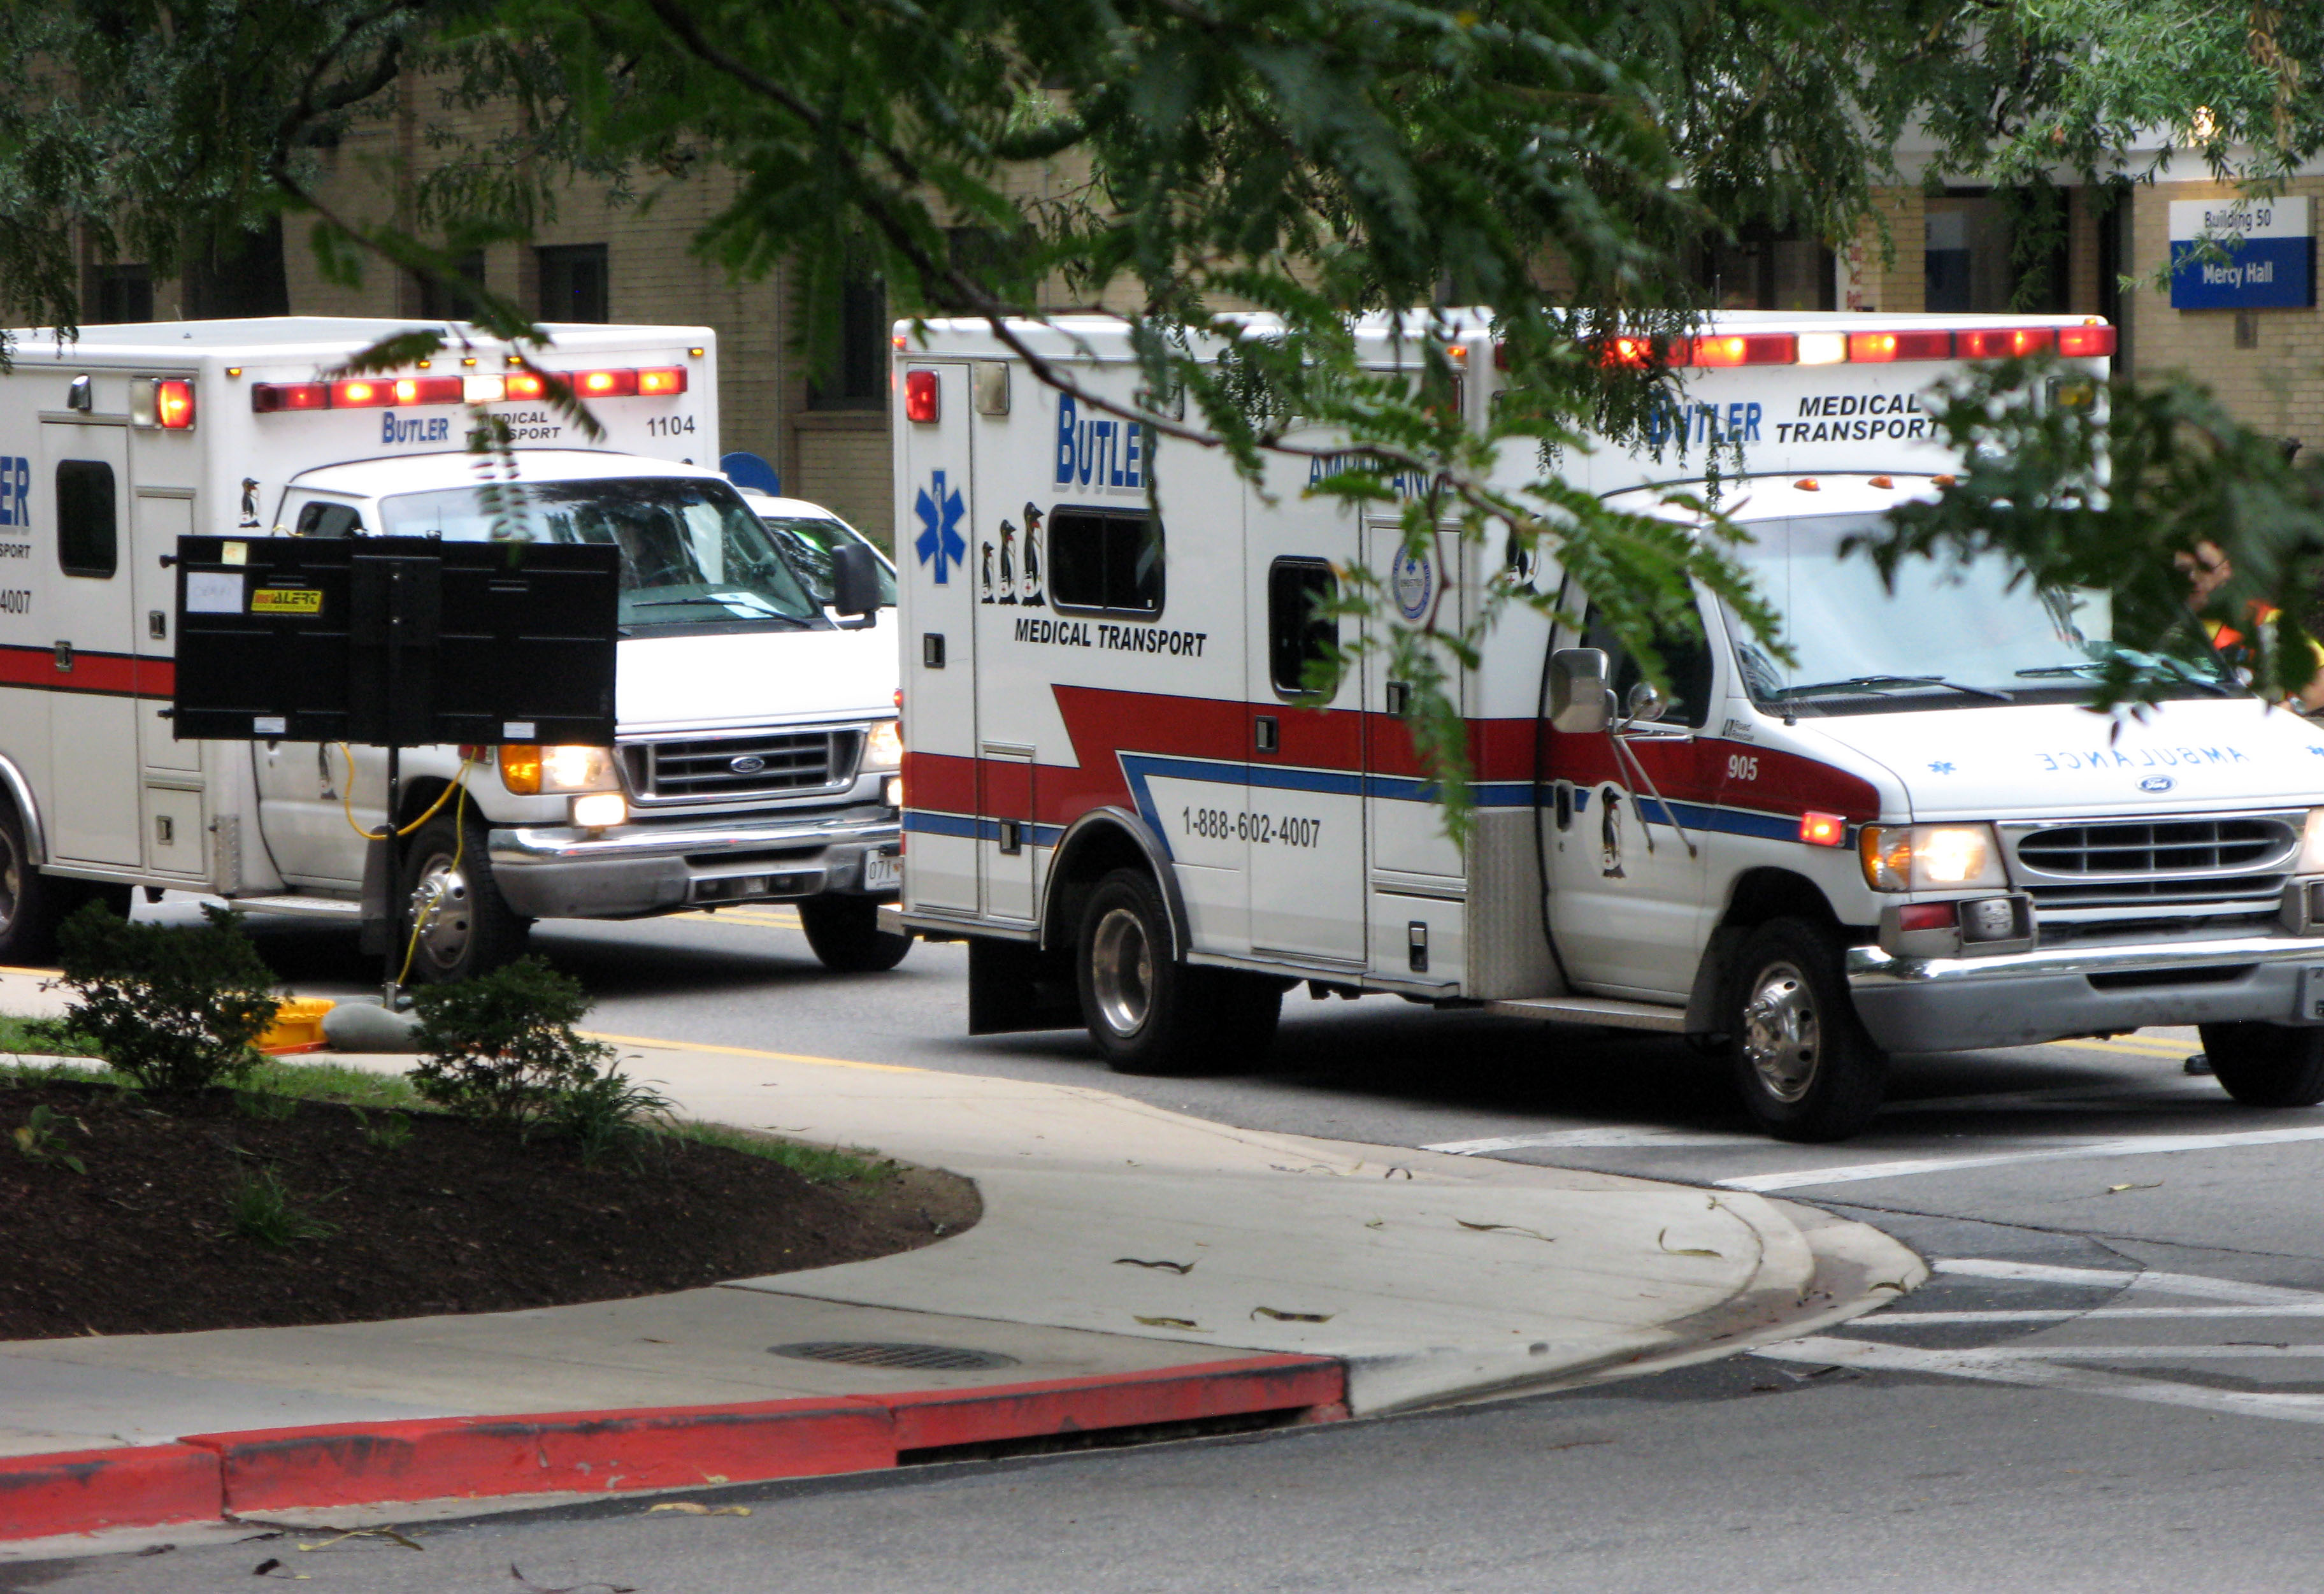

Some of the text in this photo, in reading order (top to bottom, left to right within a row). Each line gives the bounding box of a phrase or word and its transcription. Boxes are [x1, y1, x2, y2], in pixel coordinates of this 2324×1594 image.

[2204, 208, 2272, 231] Building 50
[2203, 261, 2273, 289] Mercy Hall
[478, 411, 549, 425] DICAL
[1798, 393, 1922, 417] MEDICAL
[382, 411, 448, 443] BUTLER
[466, 426, 561, 441] TSPORT
[646, 414, 696, 437] 1104
[1775, 417, 1940, 443] TRANSPORT
[1056, 391, 1157, 488] BUTLE
[1014, 618, 1207, 657] MEDICAL TRANSPORT
[1728, 754, 1759, 781] 905
[1182, 805, 1321, 848] 1-888-602-4007
